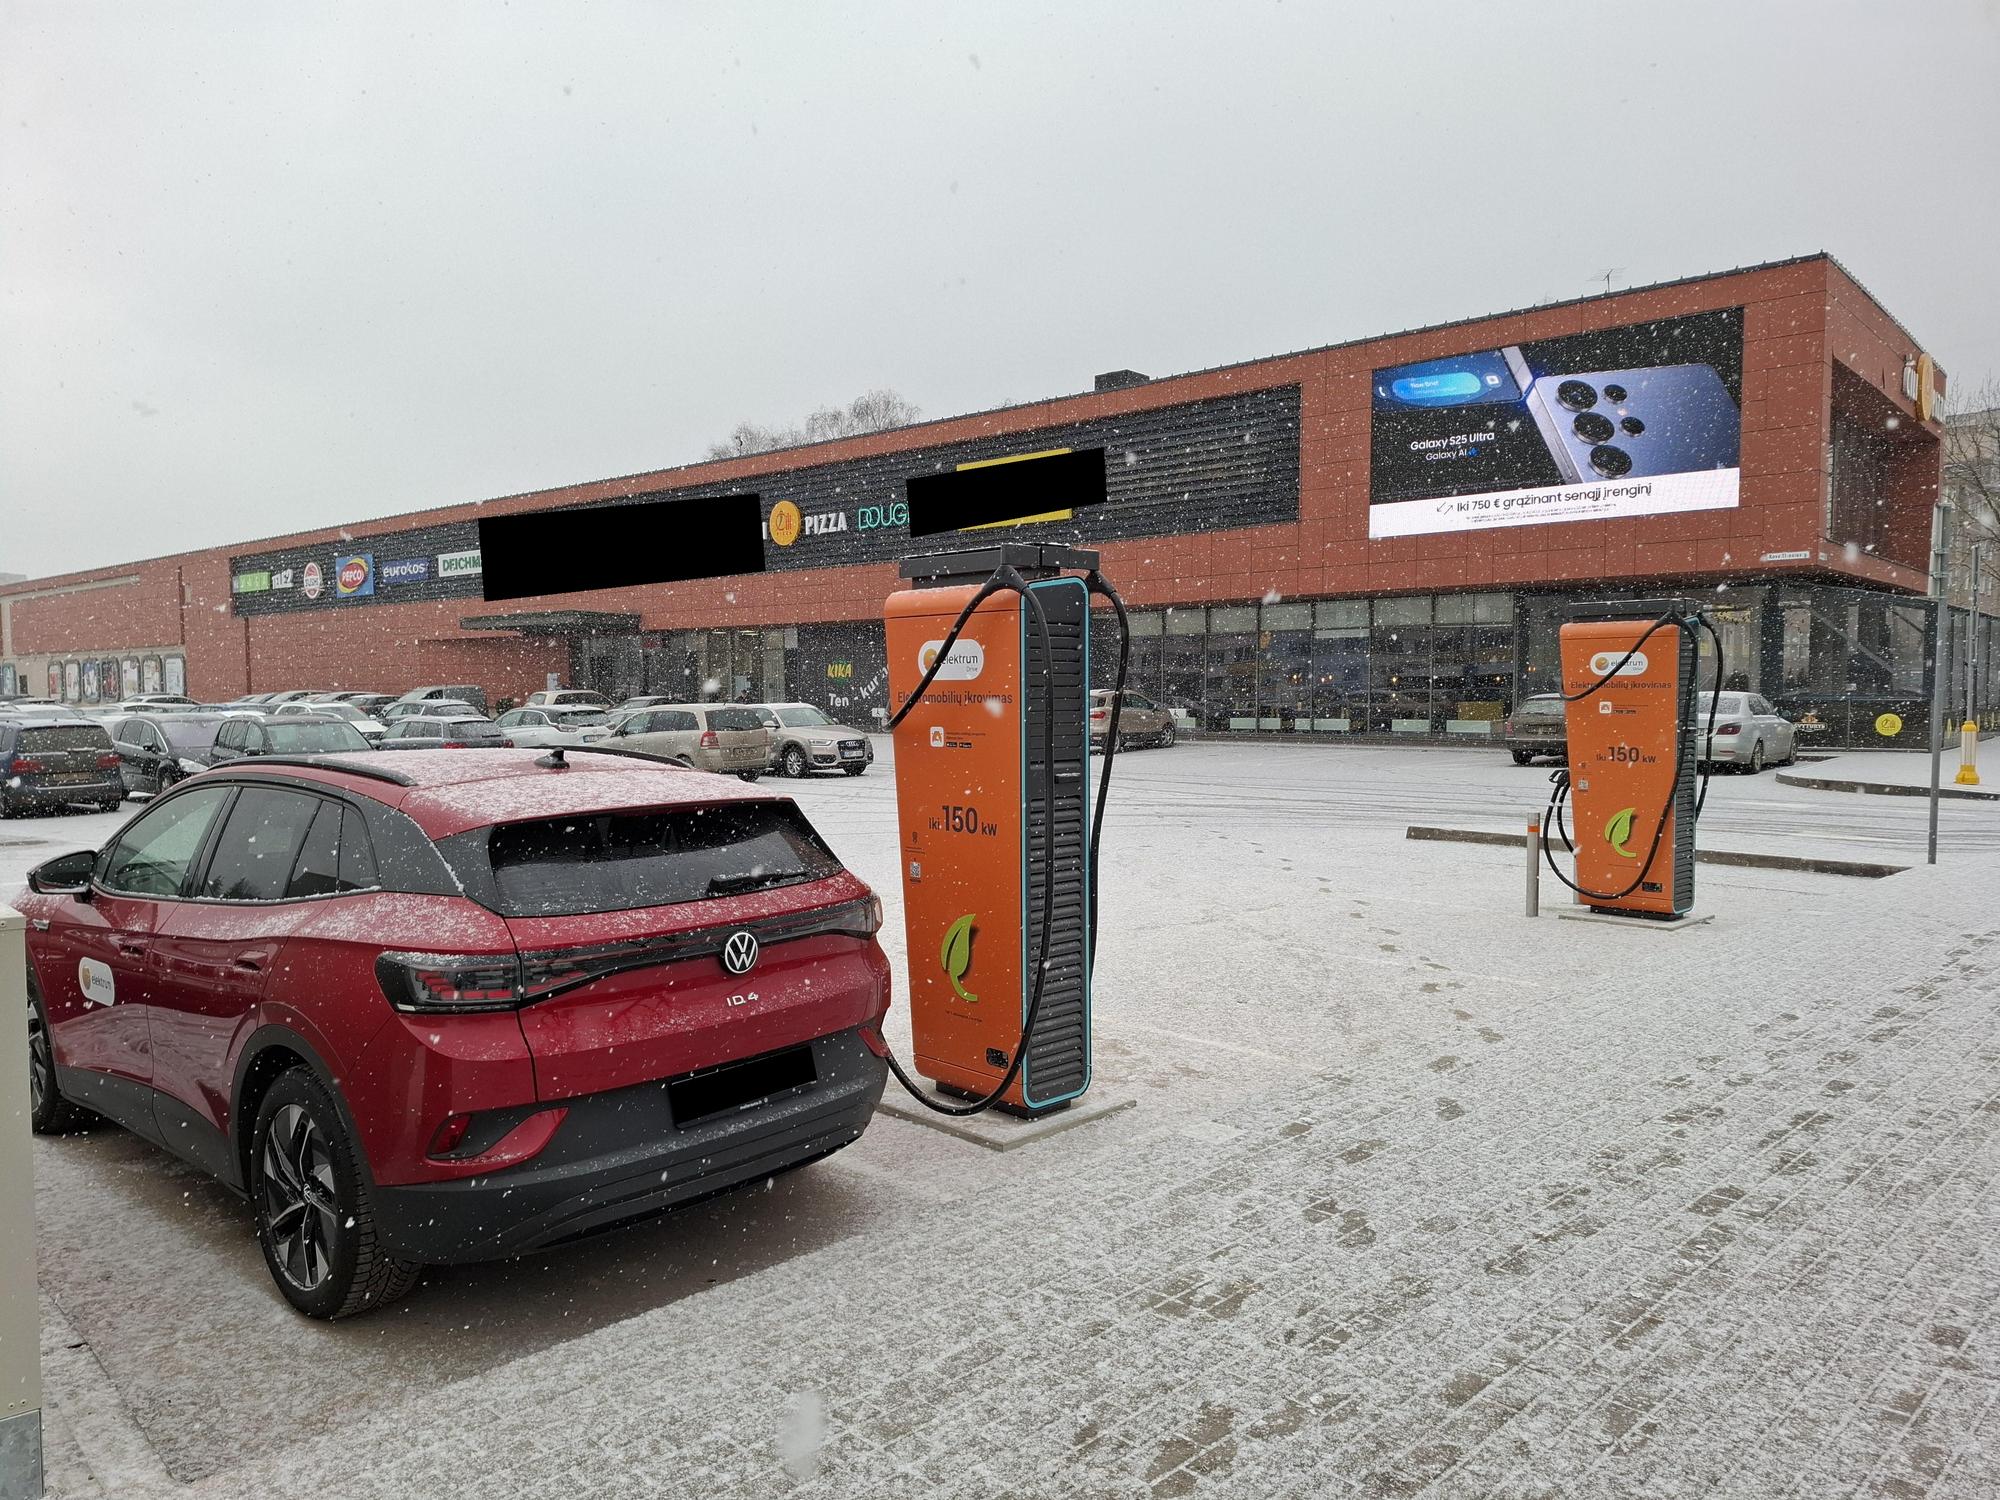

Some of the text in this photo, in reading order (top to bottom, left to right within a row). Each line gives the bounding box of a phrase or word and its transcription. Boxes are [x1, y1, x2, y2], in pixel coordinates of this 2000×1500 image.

[1410, 432, 1495, 451] Galaxy S25 Ultra
[1425, 448, 1467, 461] Galaxy AI
[1457, 501, 1470, 512] Iki
[1472, 499, 1491, 511] 750
[1494, 498, 1500, 508] €
[1503, 492, 1561, 510] grąžinant
[804, 511, 848, 535] PIZZA
[858, 503, 910, 529] DOUG
[442, 555, 482, 572] DEICHM
[341, 568, 362, 583] PEPCO
[827, 664, 852, 678] KIKA
[829, 693, 849, 706] Ten
[860, 675, 879, 699] kur
[1608, 746, 1639, 762] 150
[1642, 755, 1657, 763] kW
[942, 805, 978, 834] 150
[982, 822, 998, 836] kW
